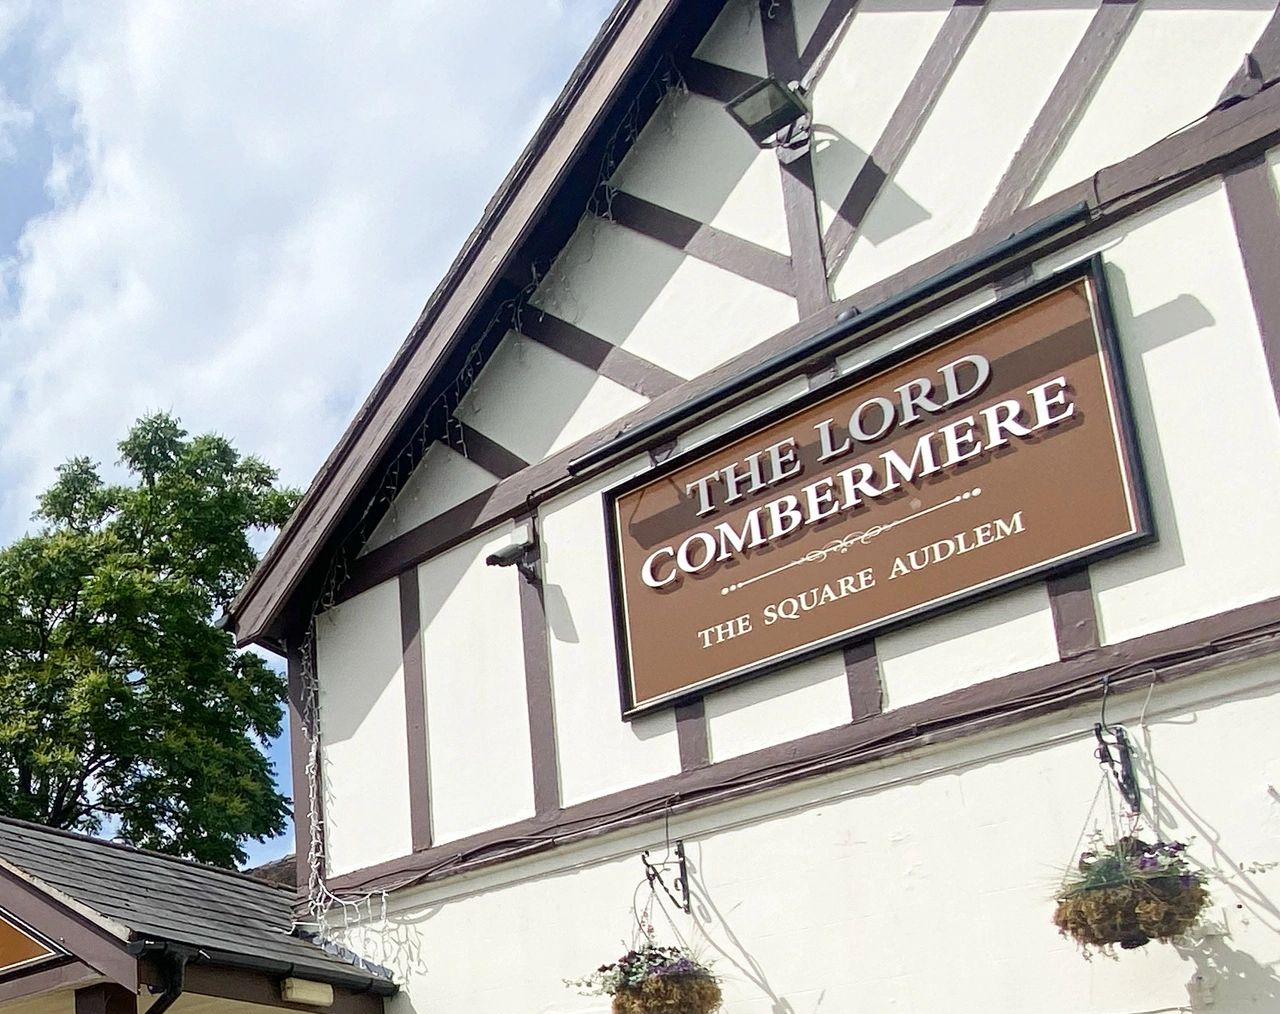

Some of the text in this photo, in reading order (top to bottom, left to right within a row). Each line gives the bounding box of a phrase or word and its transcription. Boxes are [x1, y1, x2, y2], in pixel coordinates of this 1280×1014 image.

[640, 375, 1075, 588] COMBERMERE
[687, 354, 993, 518] THE LORD
[698, 511, 1027, 650] THE SQUARE AUDLEM
